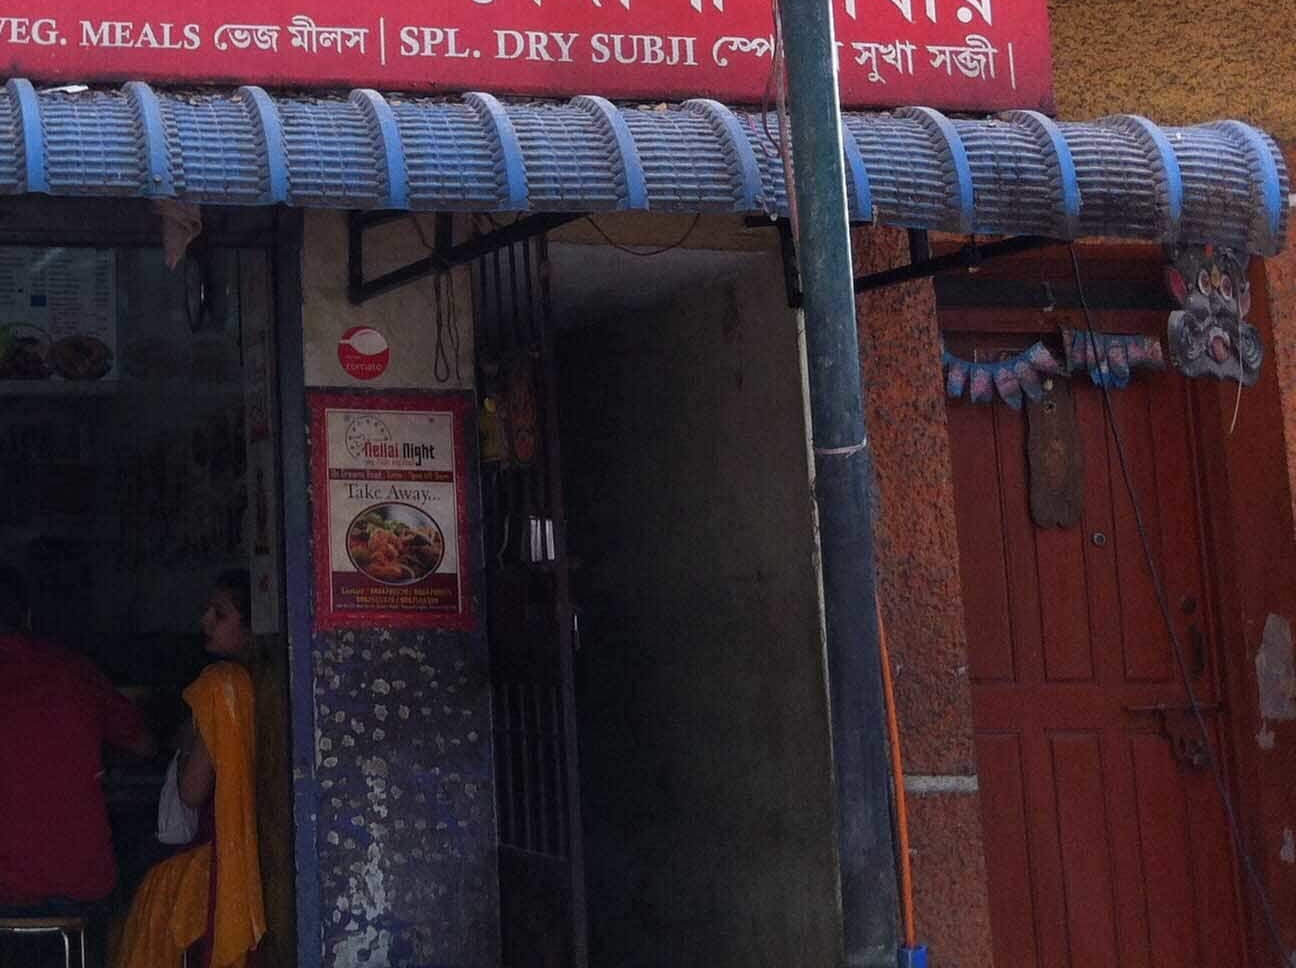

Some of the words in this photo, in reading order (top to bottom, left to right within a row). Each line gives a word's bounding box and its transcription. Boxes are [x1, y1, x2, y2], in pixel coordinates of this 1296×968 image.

[80, 22, 201, 51] MEALS
[213, 23, 280, 55] ভেজ
[287, 15, 370, 56] মীলস
[400, 26, 482, 60] SPL.
[494, 31, 580, 64] DRY
[591, 33, 699, 67] SUBJI
[344, 482, 382, 500] Take
